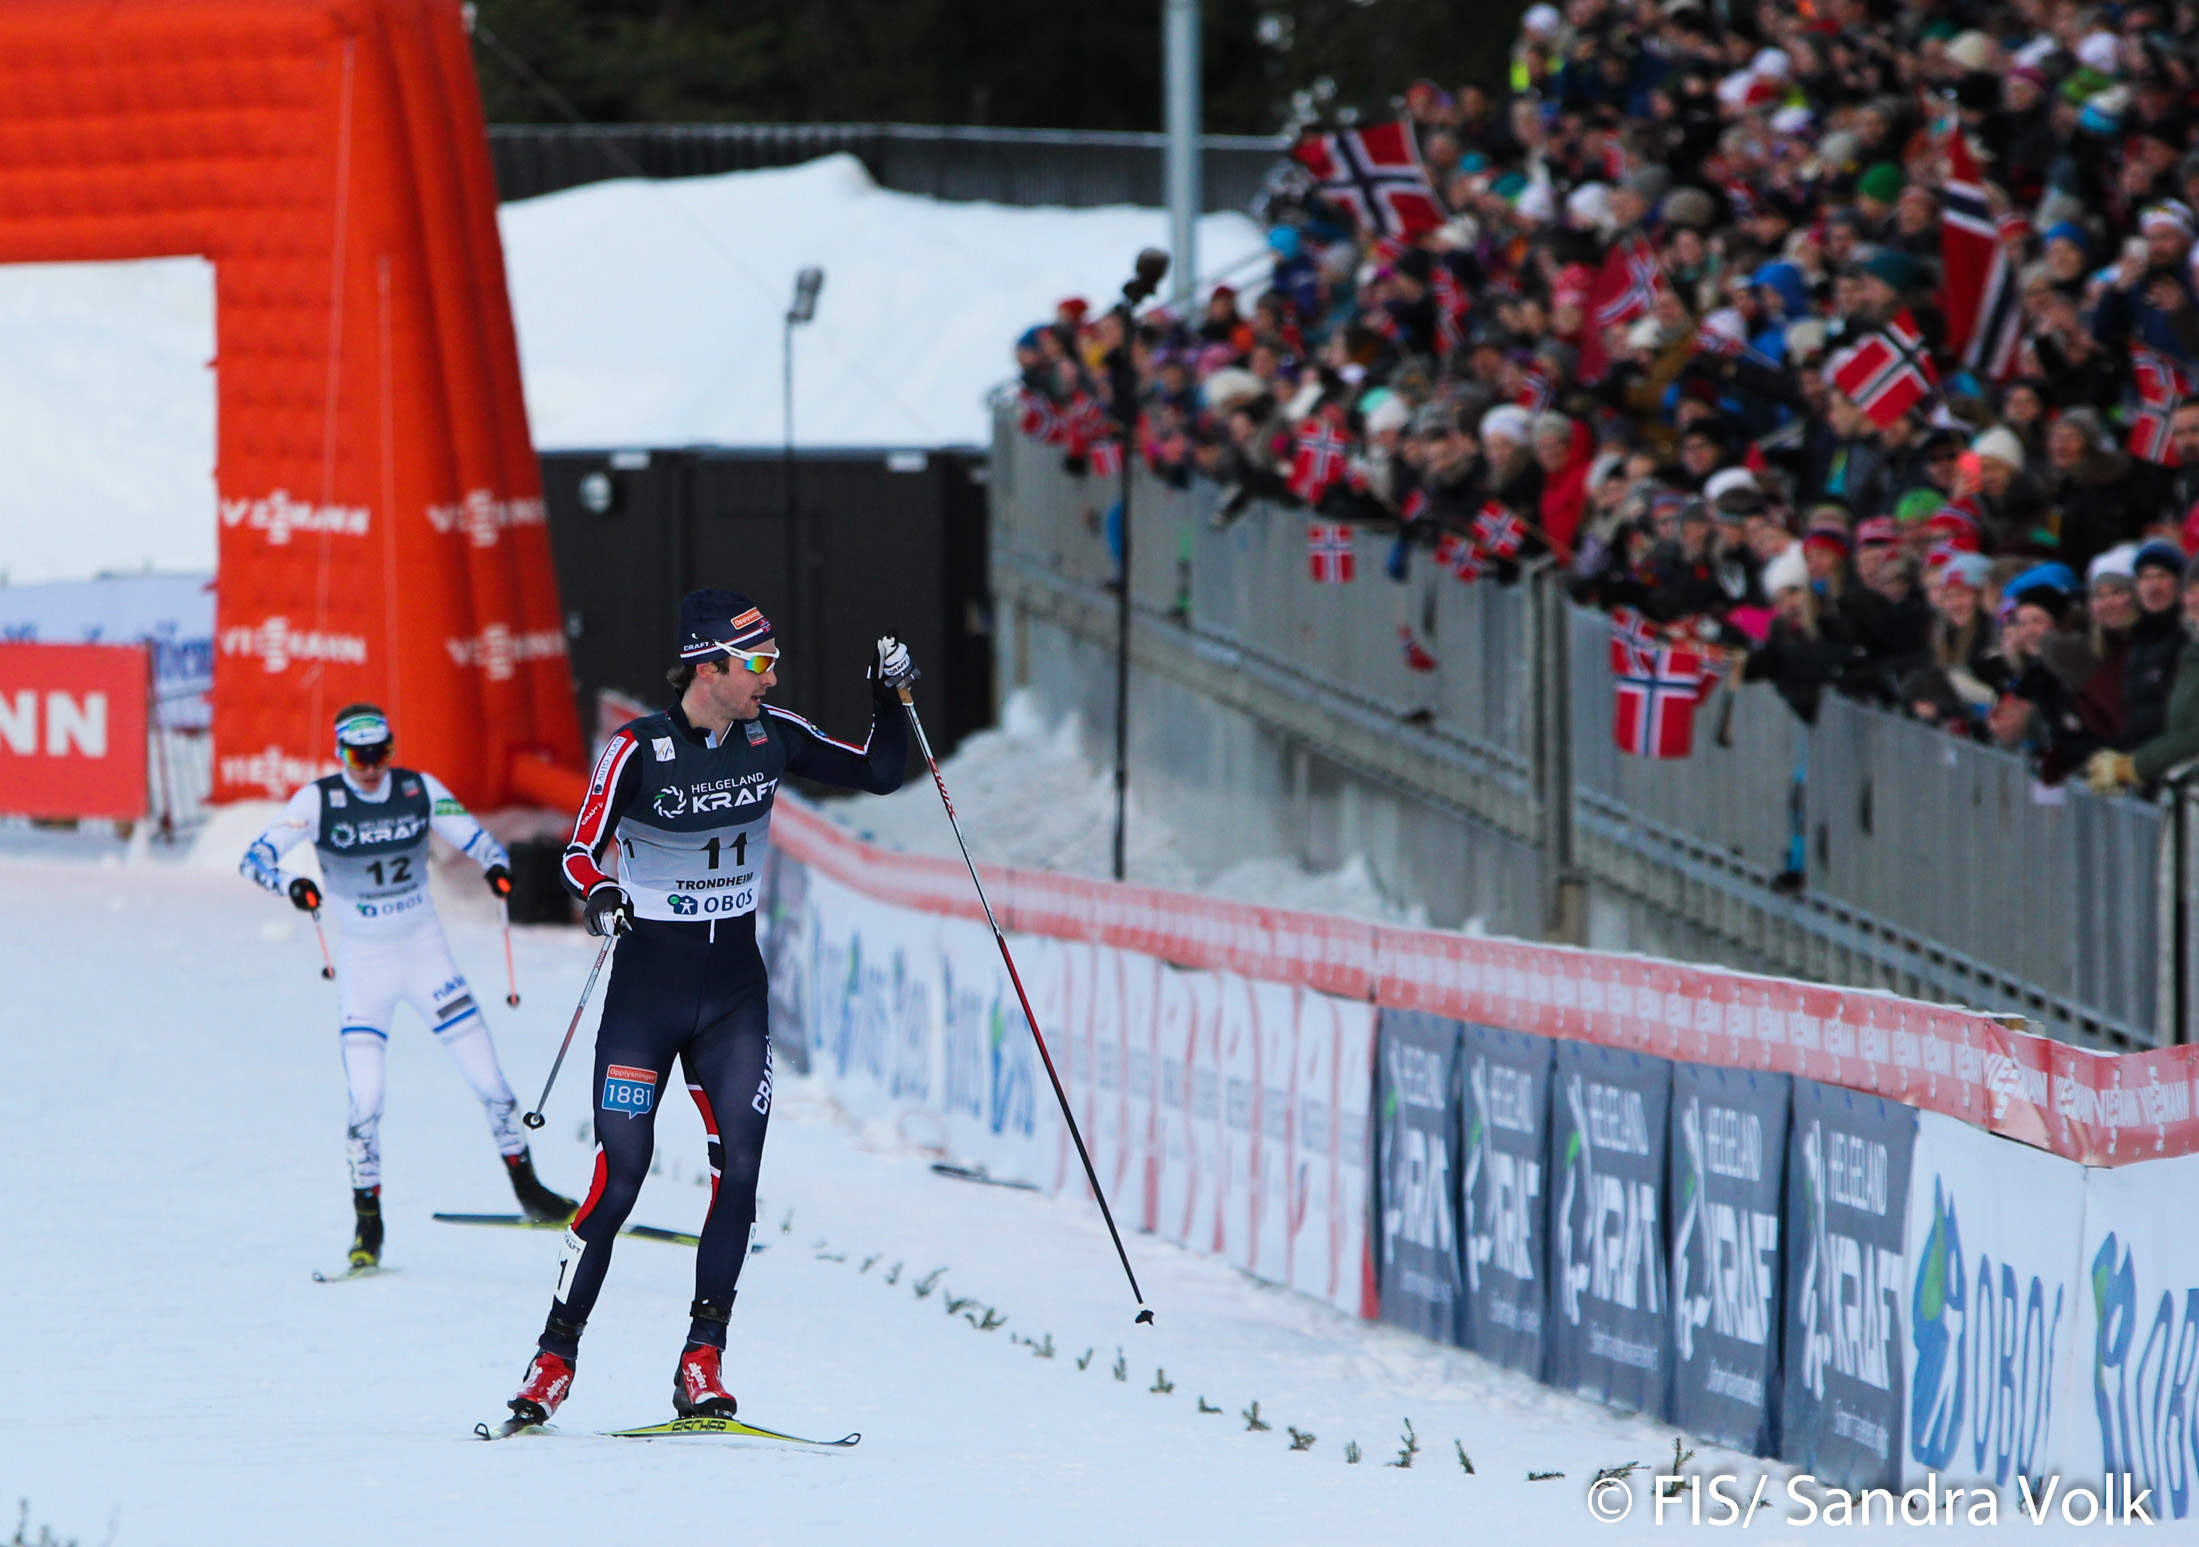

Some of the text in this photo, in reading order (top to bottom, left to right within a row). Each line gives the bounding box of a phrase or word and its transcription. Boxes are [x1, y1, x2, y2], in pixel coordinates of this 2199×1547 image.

[683, 641, 709, 651] CRAFT
[888, 660, 907, 675] CRAFT
[597, 759, 609, 783] AUTO
[691, 772, 764, 794] HELGELAND
[692, 777, 778, 814] KRAFT
[700, 832, 747, 870] 11
[366, 857, 412, 886] 12
[676, 872, 754, 890] TRONDHEIM
[704, 888, 753, 913] OBOS
[609, 1084, 650, 1107] 1881
[547, 1374, 569, 1400] alpina
[688, 1362, 708, 1390] alpina
[672, 1420, 727, 1432] FISCHER
